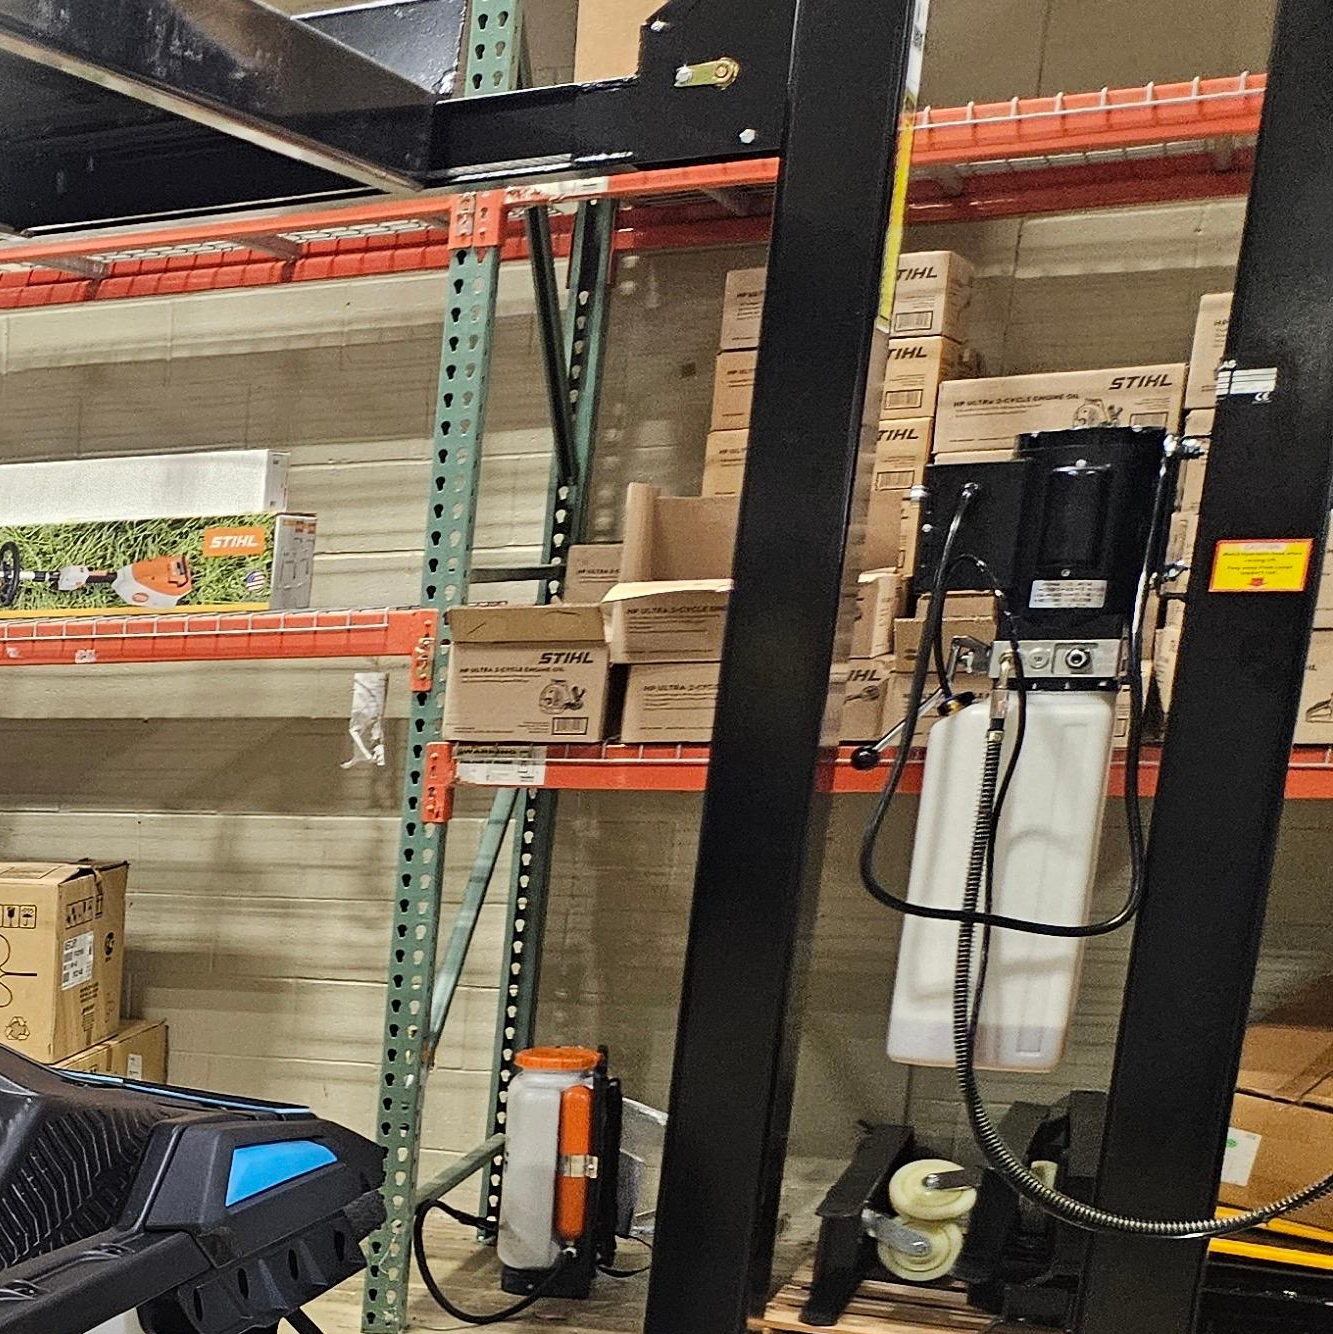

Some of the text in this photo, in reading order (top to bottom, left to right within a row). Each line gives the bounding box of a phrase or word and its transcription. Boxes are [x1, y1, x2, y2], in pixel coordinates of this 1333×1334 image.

[897, 266, 938, 281] TIHL
[887, 346, 928, 360] TIHL
[1109, 374, 1173, 391] STIHL
[877, 428, 919, 441] TIHL
[209, 535, 260, 549] STIHL
[538, 652, 594, 665] STIHL
[847, 669, 882, 682] IHL
